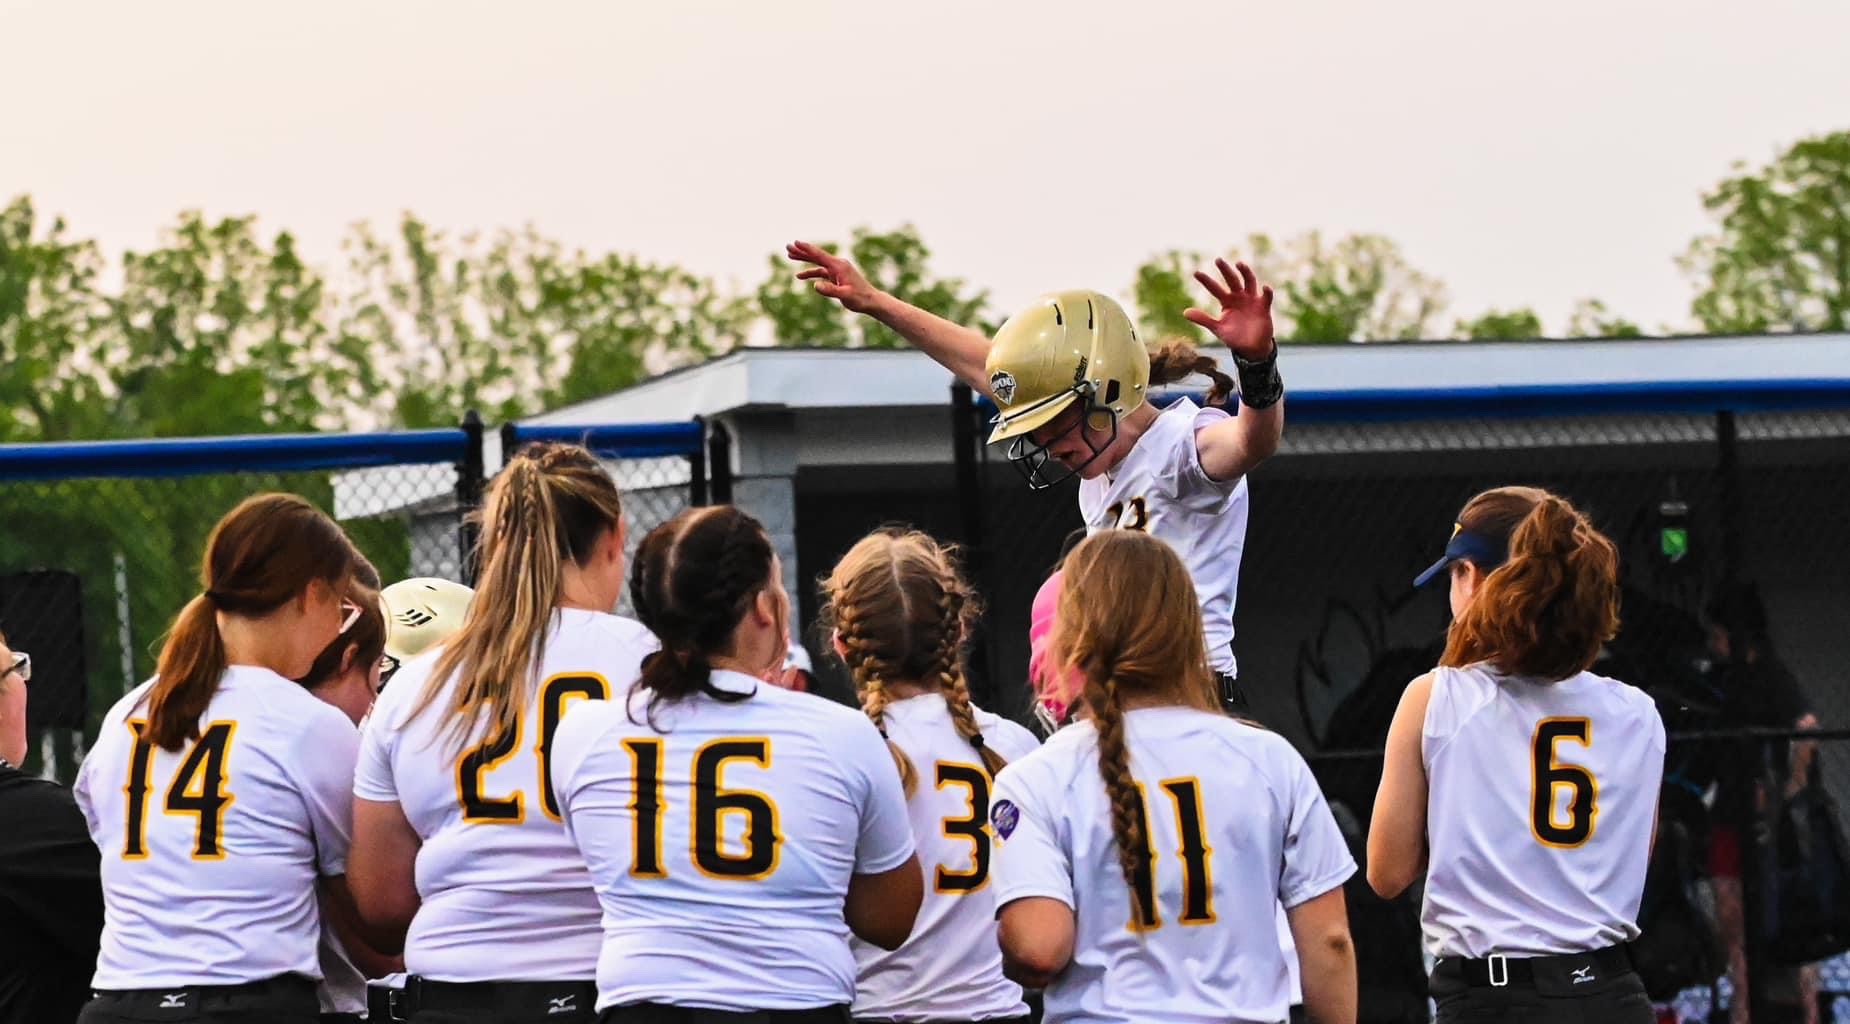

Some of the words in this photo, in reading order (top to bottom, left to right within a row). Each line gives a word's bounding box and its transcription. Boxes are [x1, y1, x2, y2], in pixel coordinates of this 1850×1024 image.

[121, 718, 237, 860] 14
[619, 736, 786, 881] 16
[933, 760, 995, 896] 3
[1530, 715, 1599, 848] 6
